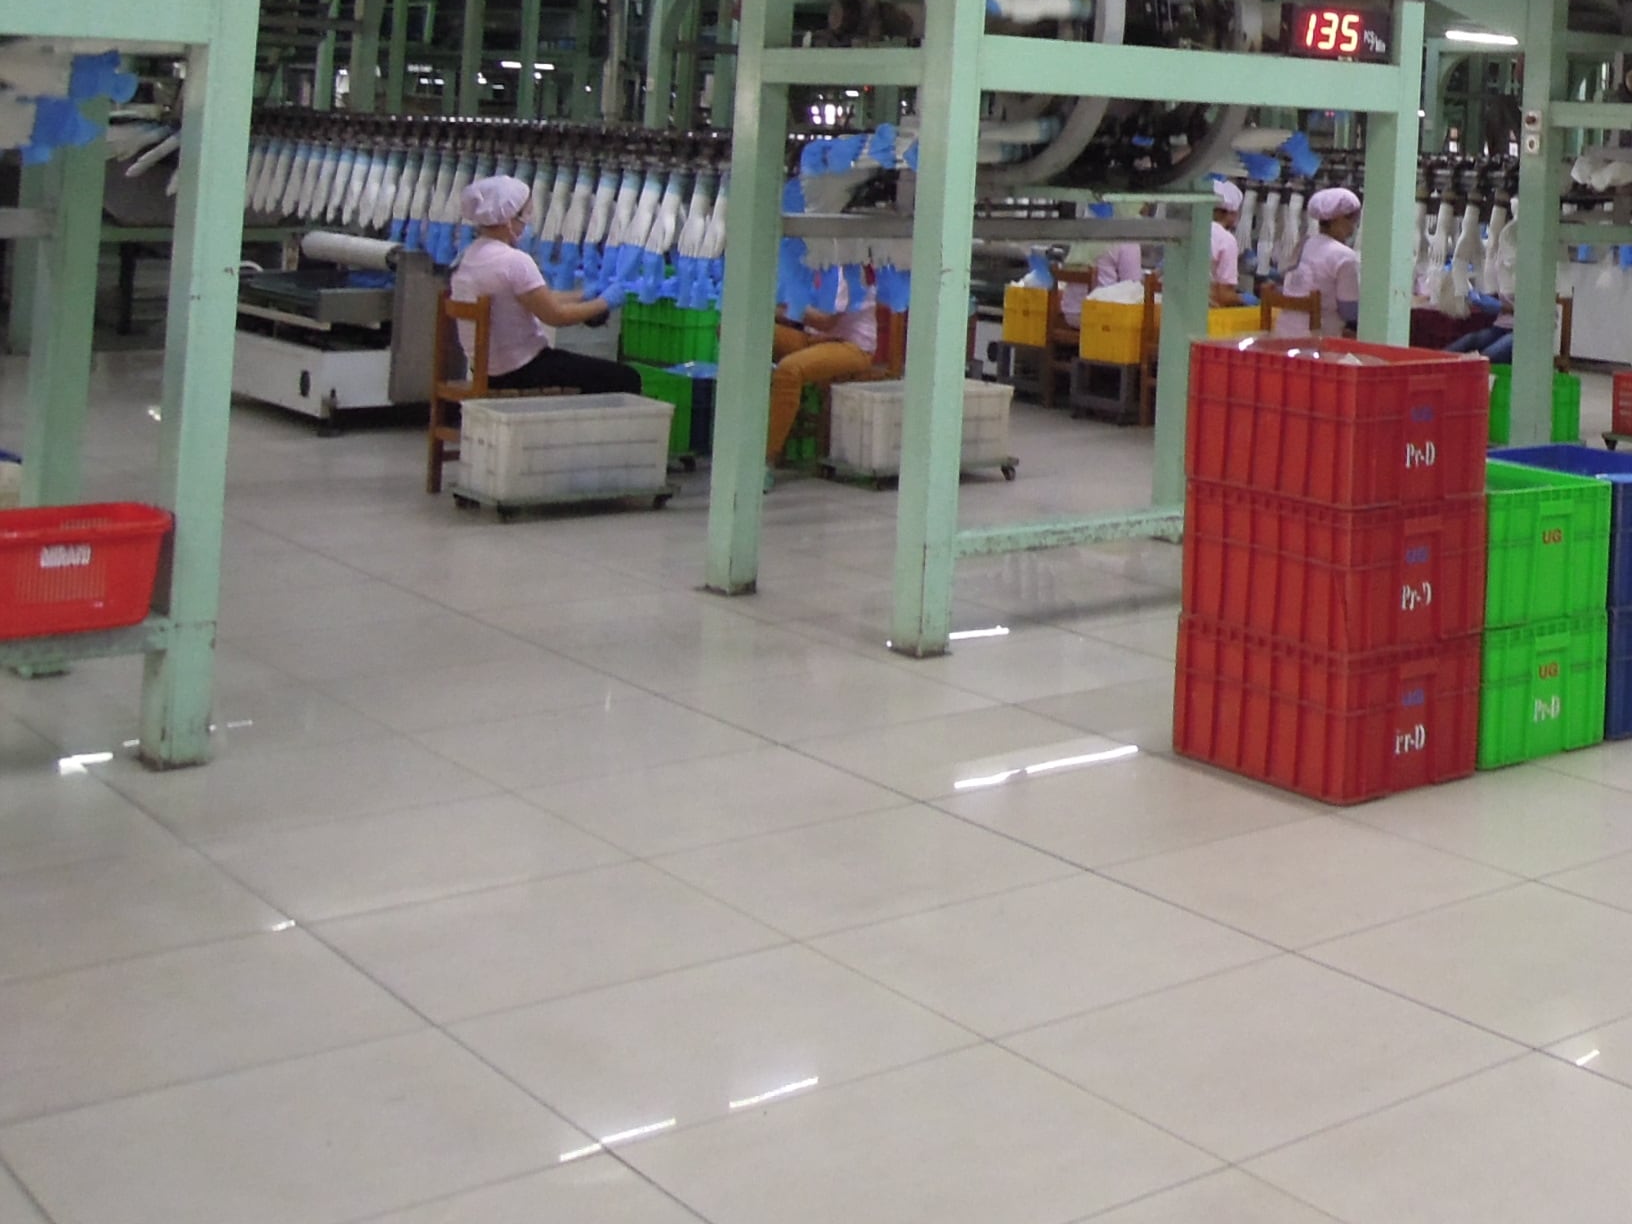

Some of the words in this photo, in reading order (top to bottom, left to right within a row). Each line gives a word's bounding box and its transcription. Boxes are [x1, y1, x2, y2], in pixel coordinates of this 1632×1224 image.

[1305, 11, 1361, 53] 135
[1405, 439, 1437, 469] Pr-D
[1542, 528, 1562, 544] UG
[1539, 661, 1560, 679] UG
